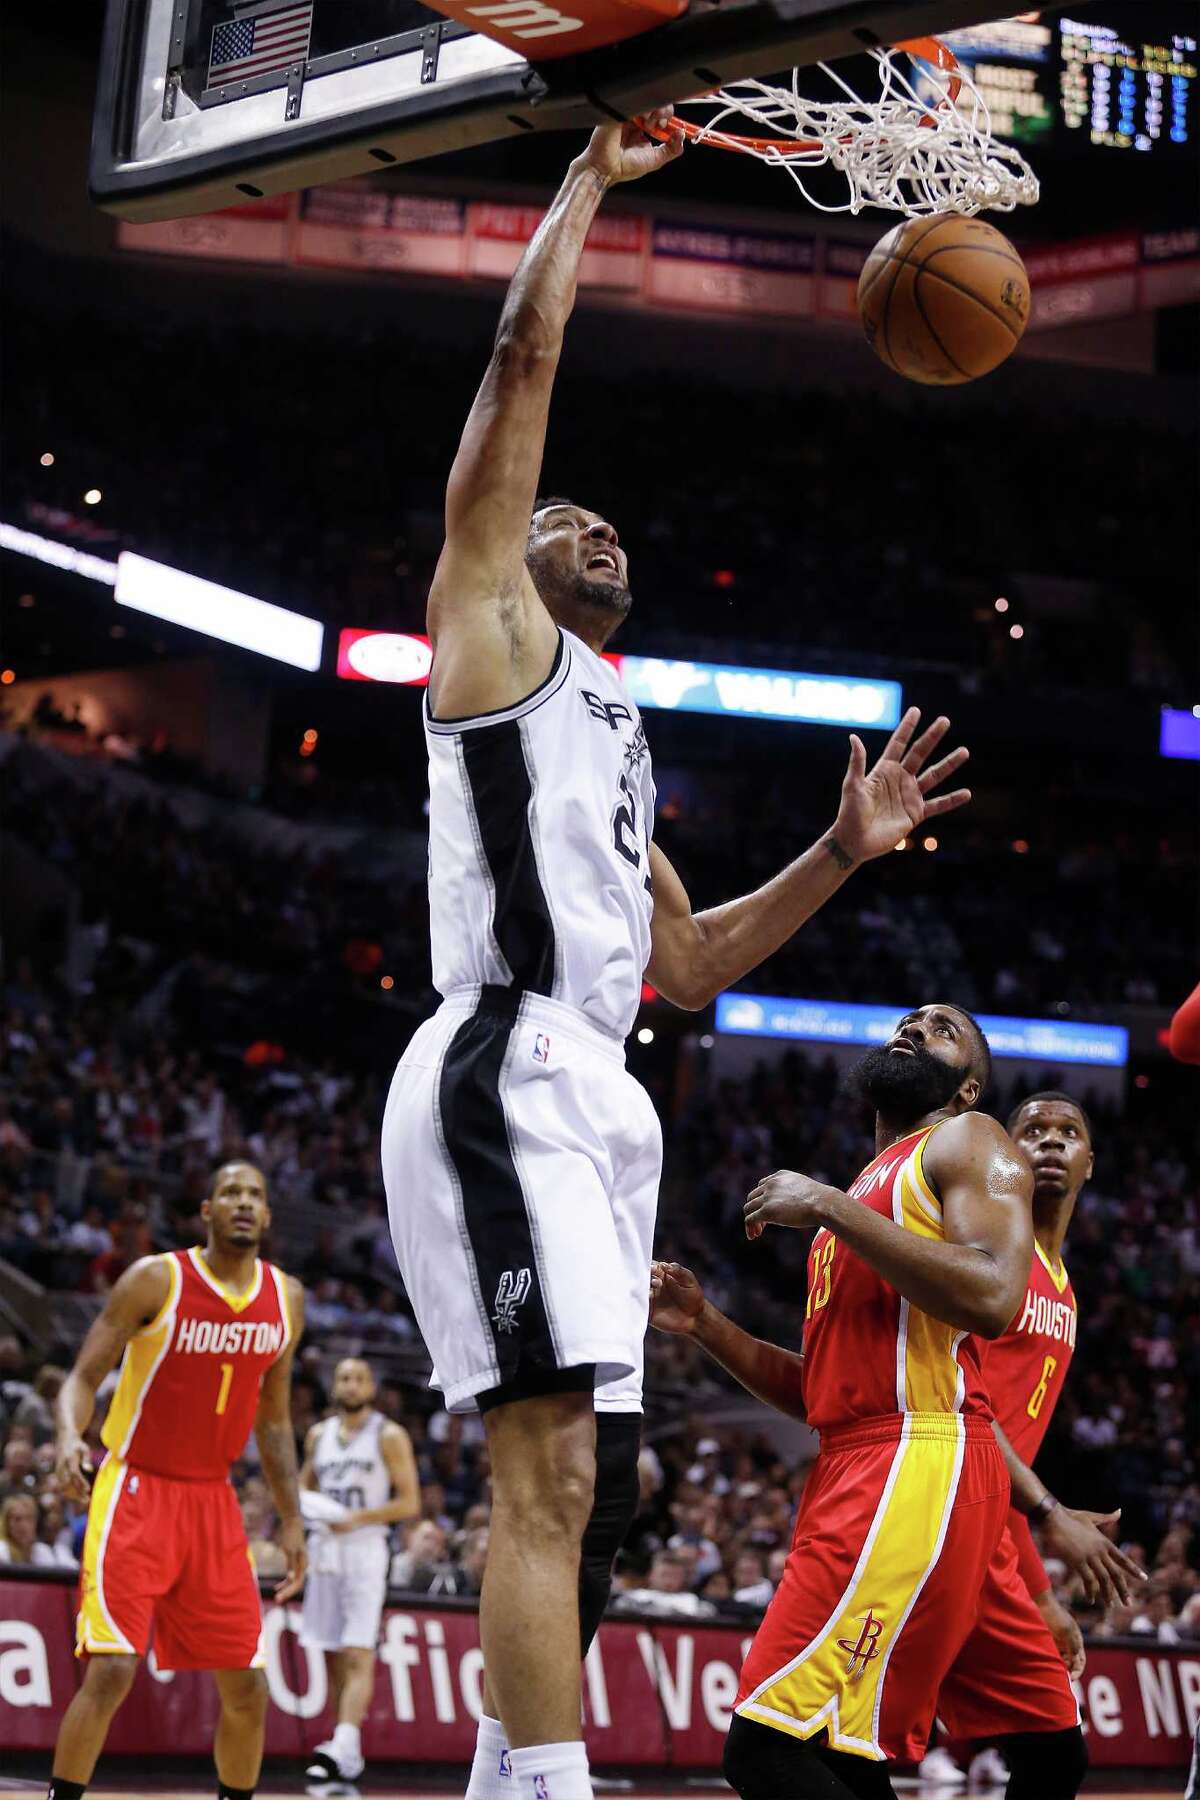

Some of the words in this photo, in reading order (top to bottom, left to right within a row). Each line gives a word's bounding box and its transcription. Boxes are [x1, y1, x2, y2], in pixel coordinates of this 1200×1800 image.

[806, 1235, 836, 1320] 13
[175, 1317, 283, 1355] HOUSTON
[215, 1362, 233, 1416] 1
[1027, 1355, 1057, 1419] 6
